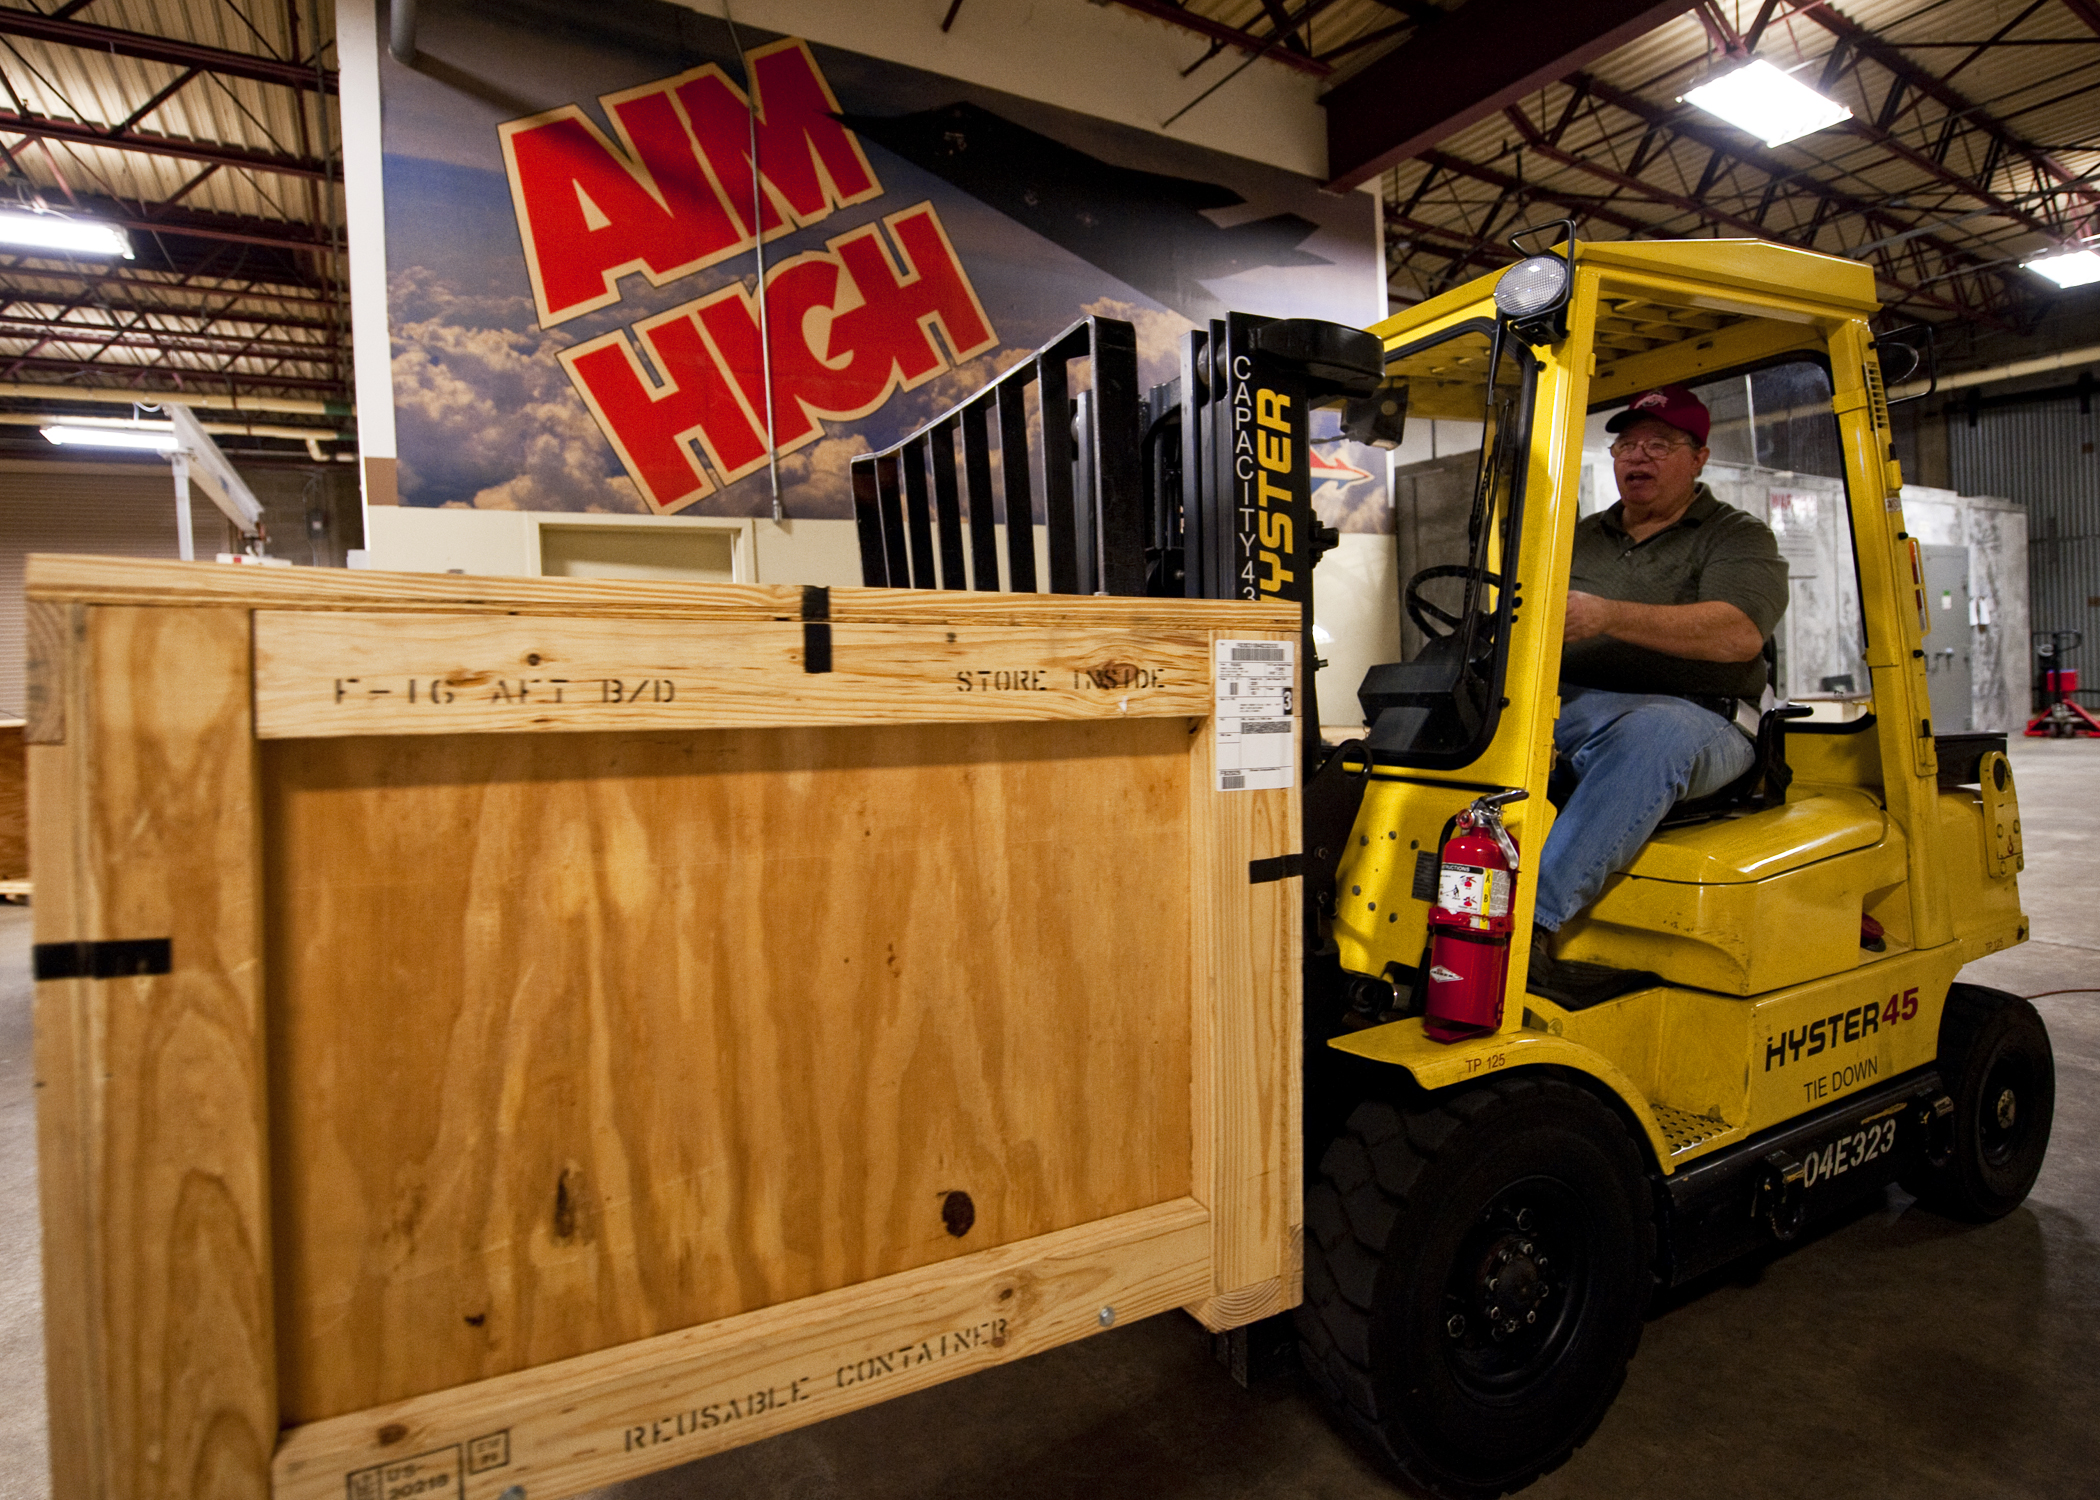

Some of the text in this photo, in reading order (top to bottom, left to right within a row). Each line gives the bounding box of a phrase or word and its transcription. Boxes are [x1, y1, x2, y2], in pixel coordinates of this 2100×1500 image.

[497, 36, 885, 331] AIM
[555, 200, 1000, 517] HIGH
[1233, 355, 1257, 557] CAPACITY
[1256, 388, 1295, 600] YSTER
[491, 678, 569, 704] AFT
[602, 678, 675, 704] B/D
[956, 668, 1165, 692] STORE INSIDE
[1283, 691, 1293, 711] 3
[1465, 1053, 1506, 1073] TP 125
[1765, 987, 1919, 1072] HYSTER 45
[1803, 1055, 1878, 1102] TIE DOWN
[1803, 1118, 1897, 1188] 04E323
[624, 1318, 1009, 1453] REUSABLE CONTAINER
